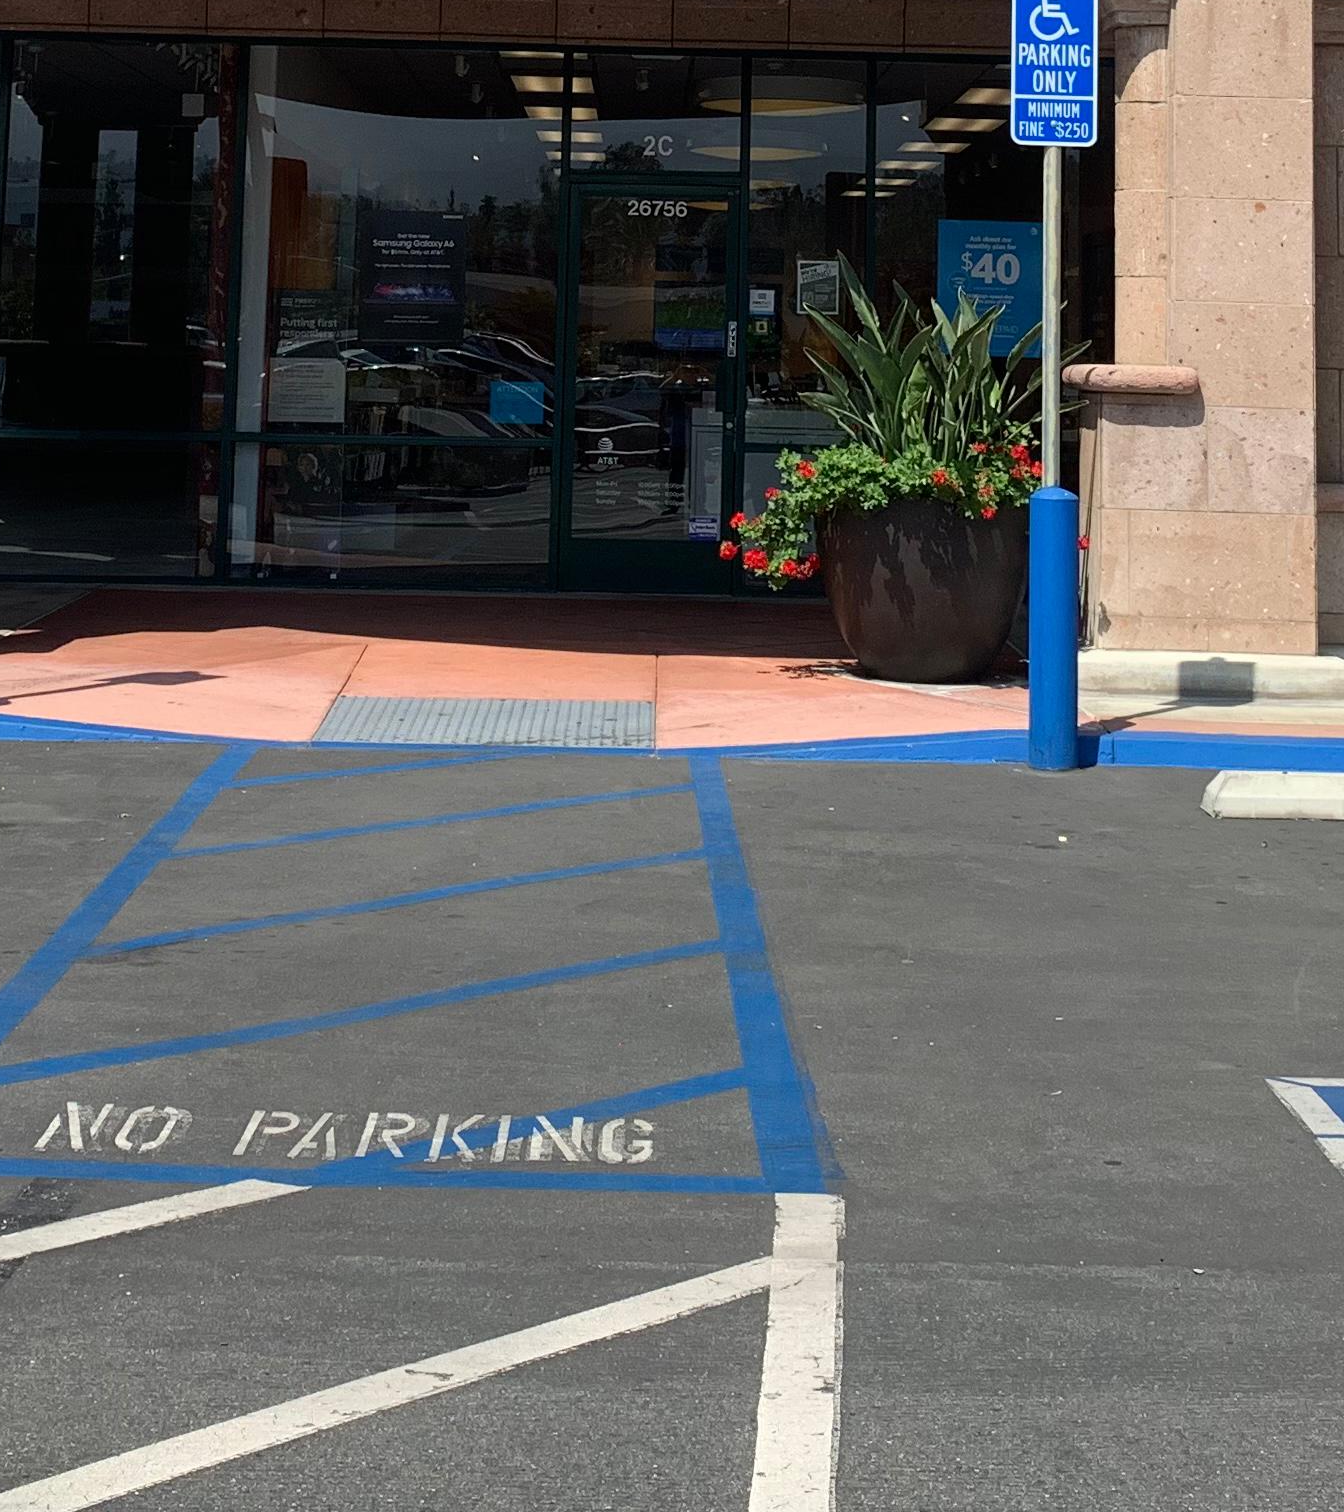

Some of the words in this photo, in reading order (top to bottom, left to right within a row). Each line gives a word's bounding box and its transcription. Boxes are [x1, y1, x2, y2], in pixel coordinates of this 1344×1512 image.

[1017, 43, 1092, 68] PARKING
[1032, 69, 1078, 94] ONLY
[1027, 101, 1081, 119] MINIMUM
[1018, 120, 1046, 138] FINE
[1054, 120, 1089, 139] $250
[642, 135, 674, 157] 2C
[627, 199, 688, 217] 26756
[372, 238, 413, 249] Samsung
[413, 239, 443, 249] Galaxy
[960, 251, 1021, 285] $40
[280, 317, 317, 329] Putting
[317, 318, 338, 328] first
[597, 456, 619, 465] AT&T
[33, 1100, 194, 1154] NO
[232, 1108, 656, 1166] PARKING
